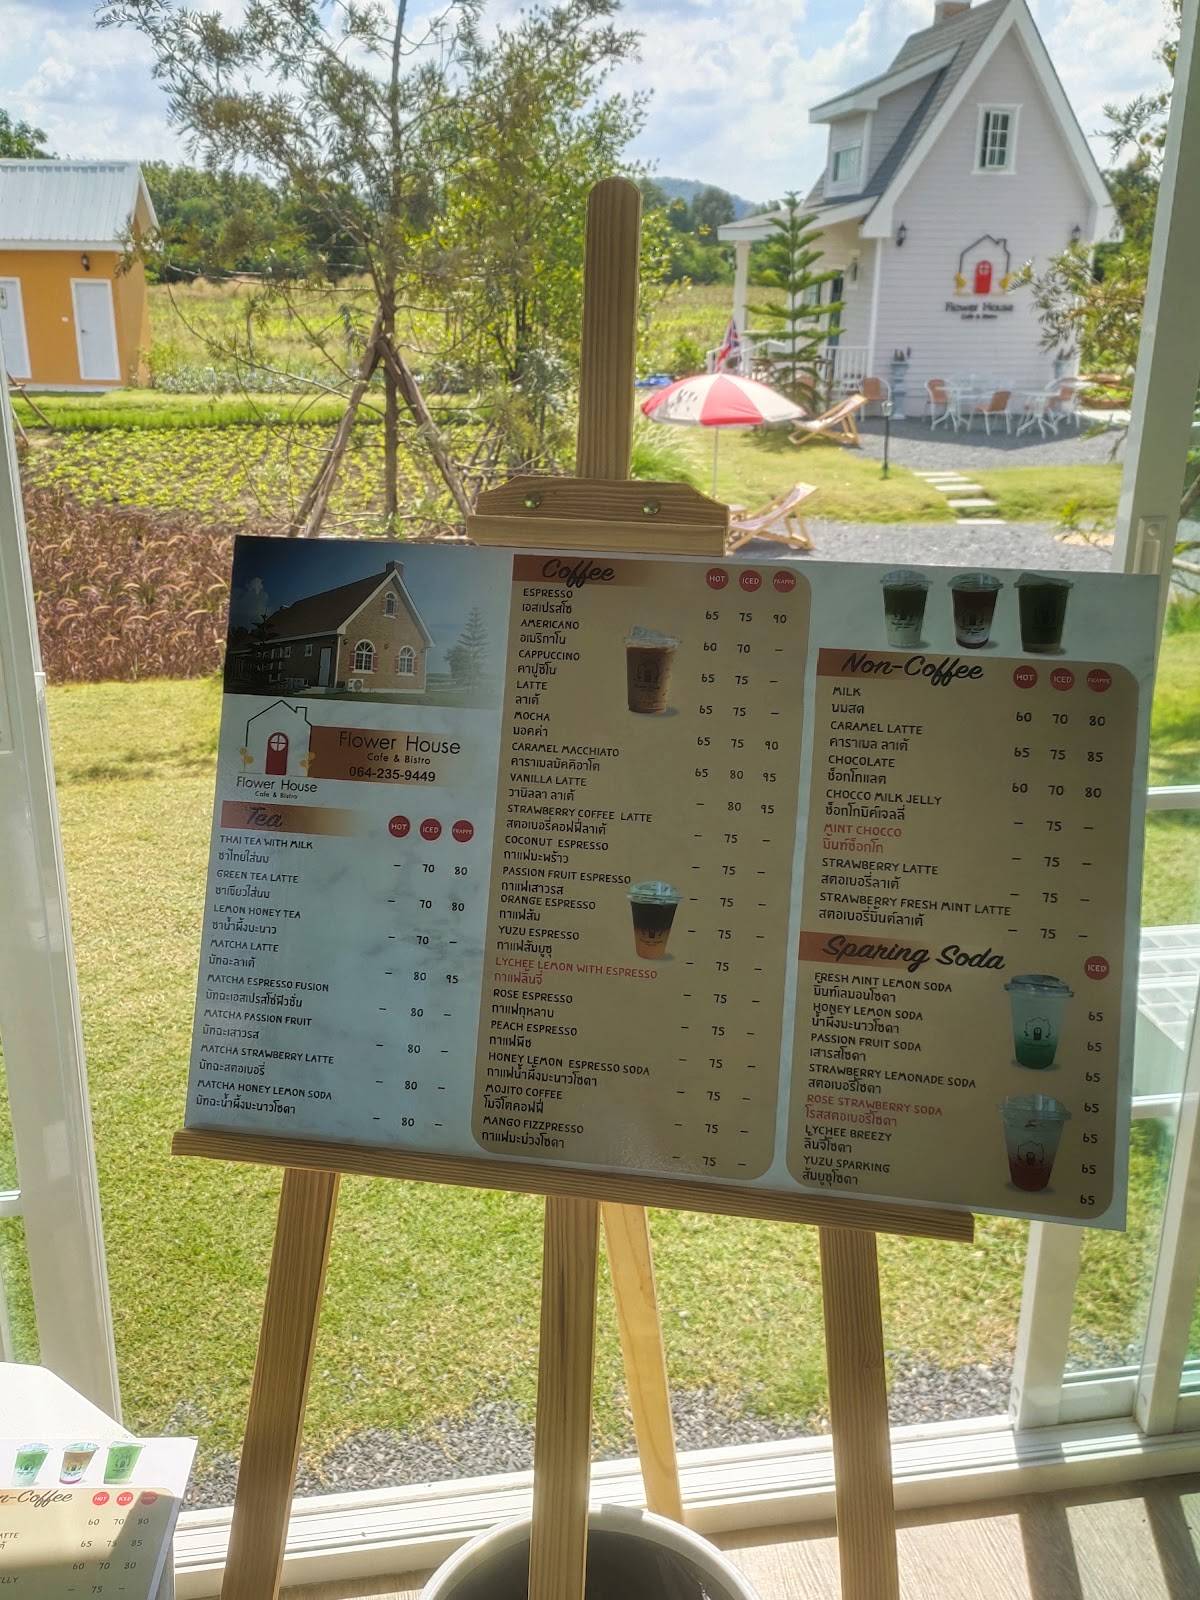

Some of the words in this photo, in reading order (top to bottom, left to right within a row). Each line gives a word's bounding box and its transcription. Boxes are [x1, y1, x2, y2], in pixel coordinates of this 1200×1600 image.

[542, 558, 615, 588] Coffee
[709, 575, 726, 583] HOT
[741, 576, 760, 585] ICED
[522, 587, 573, 599] ESPRESSO
[519, 617, 580, 630] AMERICANO
[705, 610, 719, 620] 65
[738, 612, 752, 622] 75
[772, 613, 787, 624] 90
[518, 649, 580, 661] CAPPUCCINO
[841, 652, 984, 687] Non-Coffee
[515, 679, 548, 690] LATTE
[1016, 673, 1034, 681] HOT
[1053, 675, 1072, 683] ICED
[831, 685, 861, 697] MILK
[513, 711, 550, 722] MOCHA
[830, 720, 884, 733] CARAMEL
[886, 723, 923, 735] LATTE
[339, 731, 397, 751] Flower
[406, 735, 461, 755] House
[511, 741, 559, 754] CARAMEL
[560, 745, 620, 757] MACCHIATO
[367, 752, 389, 762] Cafe
[393, 755, 400, 763] &
[404, 755, 431, 765] Bistro
[827, 754, 895, 768] CHOCOLATE
[1013, 746, 1030, 758] 65
[1049, 748, 1066, 760] 75
[1087, 751, 1103, 763] 85
[349, 766, 436, 782] 064-235-9449
[509, 772, 552, 784] VANILLA
[555, 775, 587, 787] LATTE
[236, 775, 275, 790] Flower
[281, 779, 318, 793] House
[825, 788, 871, 801] CHOCCO
[873, 791, 903, 803] MILK
[905, 794, 942, 806] JELLY
[246, 807, 283, 828] Tea
[506, 803, 576, 817] STRAWBERRY
[577, 808, 615, 820] COFFEE
[620, 811, 653, 823] LATTE
[391, 823, 408, 831] HOT
[422, 826, 439, 834] ICED
[823, 823, 853, 833] MINT
[855, 825, 902, 837] CHOCCO
[219, 834, 242, 845] THAI
[243, 836, 262, 845] TEA
[263, 837, 288, 847] WITH
[289, 840, 313, 849] MILK
[504, 834, 553, 847] COCONUT
[557, 838, 609, 851] ESPRESSO
[421, 863, 435, 873] 70
[454, 865, 468, 876] 80
[821, 857, 900, 872] STRAWBERRY
[902, 863, 938, 875] LATTE
[216, 869, 247, 879] GREEN
[249, 871, 267, 881] TEA
[269, 873, 298, 883] LATTE
[502, 865, 545, 878] PASSION
[547, 869, 577, 880] FRUIT
[579, 872, 631, 884] ESPRESSO
[500, 893, 543, 906] ORANGE
[544, 897, 596, 910] ESPRESSO
[819, 891, 898, 907] STRAWBERRY
[900, 897, 937, 910] FRESH
[940, 901, 971, 913] MINT
[974, 903, 1012, 916] LATTE
[213, 904, 246, 914] LEMON
[248, 906, 281, 917] HONEY
[283, 909, 301, 919] TEA
[497, 925, 526, 936] YUZU
[528, 927, 579, 940] ESPRESSO
[210, 939, 248, 949] MATCHA
[249, 942, 279, 952] LATTE
[821, 934, 931, 973] Sparing
[935, 944, 1007, 970] Soda
[495, 956, 535, 969] LYCHEE
[537, 960, 573, 972] LEMON
[576, 963, 603, 974] WITH
[605, 966, 657, 979] ESPRESSO
[1087, 964, 1107, 972] ICED
[206, 974, 245, 984] MATCHA
[246, 977, 293, 989] ESPRESSO
[294, 981, 329, 992] FUSION
[413, 971, 427, 981] 80
[445, 974, 459, 984] 95
[814, 971, 849, 984] FRESH
[851, 975, 880, 986] MINT
[882, 977, 921, 990] LEMON
[923, 981, 952, 992] SODA
[492, 988, 520, 999] ROSE
[521, 990, 573, 1004] ESPRESSO
[203, 1009, 242, 1020] MATCHA
[243, 1012, 282, 1023] PASSION
[284, 1015, 312, 1026] FRUIT
[812, 1002, 852, 1014] HONEY
[853, 1005, 892, 1018] LEMON
[894, 1009, 923, 1021] SODA
[1088, 1011, 1103, 1022] 65
[490, 1019, 524, 1031] PEACH
[526, 1023, 578, 1036] ESPRESSO
[810, 1032, 856, 1046] PASSION
[858, 1036, 891, 1048] FRUIT
[892, 1040, 921, 1051] SODA
[200, 1044, 239, 1055] MATCHA
[240, 1047, 303, 1061] STRAWBERRY
[304, 1053, 334, 1064] LATTE
[488, 1050, 525, 1064] HONEY
[526, 1055, 563, 1068] LEMON
[568, 1059, 620, 1073] ESPRESSO
[622, 1064, 650, 1076] SODA
[808, 1063, 882, 1078] STRAWBERRY
[884, 1070, 944, 1085] LEMONADE
[946, 1076, 976, 1088] SODA
[196, 1079, 235, 1090] MATCHA
[237, 1083, 271, 1094] HONEY
[272, 1086, 305, 1097] LEMON
[307, 1089, 332, 1100] SODA
[484, 1083, 523, 1096] MOJITO
[525, 1087, 563, 1100] COFFEE
[806, 1094, 834, 1105] ROSE
[837, 1096, 910, 1112] STRAWBERRY
[913, 1104, 942, 1115] SODA
[1083, 1101, 1099, 1114] 65
[482, 1113, 521, 1128] MANGO
[522, 1117, 584, 1134] FIZZPRESSO
[804, 1123, 846, 1137] LYCHEE
[849, 1128, 892, 1141] BREEZY
[802, 1154, 833, 1167] YUZU
[835, 1158, 890, 1173] SPARKING
[88, 1518, 100, 1526] 60
[72, 1562, 85, 1570] 60
[99, 1562, 111, 1570] 70
[124, 1562, 137, 1570] 80
